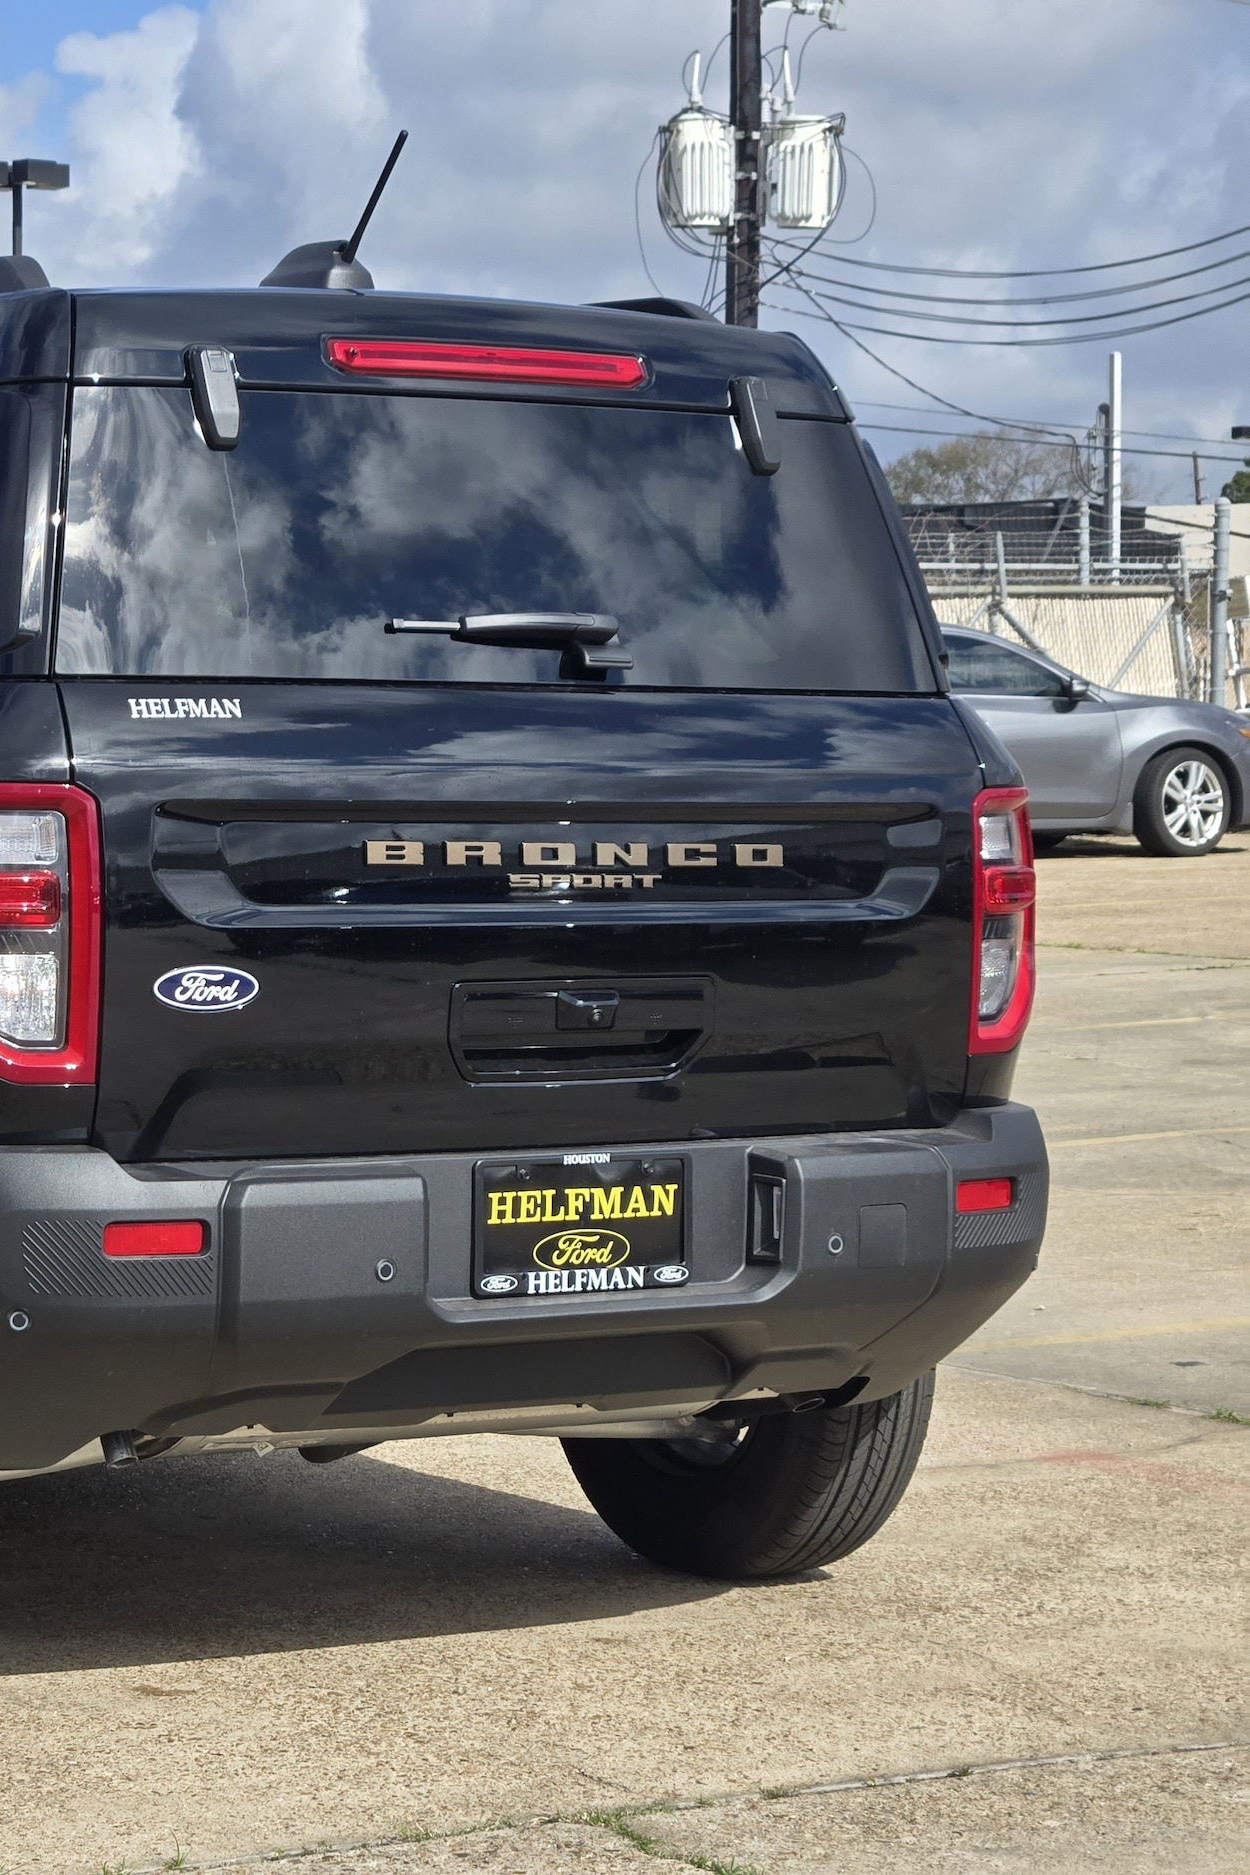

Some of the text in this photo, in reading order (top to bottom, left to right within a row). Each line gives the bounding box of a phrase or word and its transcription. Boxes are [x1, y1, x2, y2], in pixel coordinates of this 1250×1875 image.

[128, 698, 243, 719] HELFMAN
[364, 840, 784, 867] BRONCO
[508, 873, 662, 888] SPORT
[174, 972, 240, 1002] Ford
[563, 1153, 611, 1165] HOUSTON
[487, 1184, 679, 1225] HELFMAN
[551, 1234, 614, 1266] Ford
[526, 1266, 647, 1295] HELFMAN
